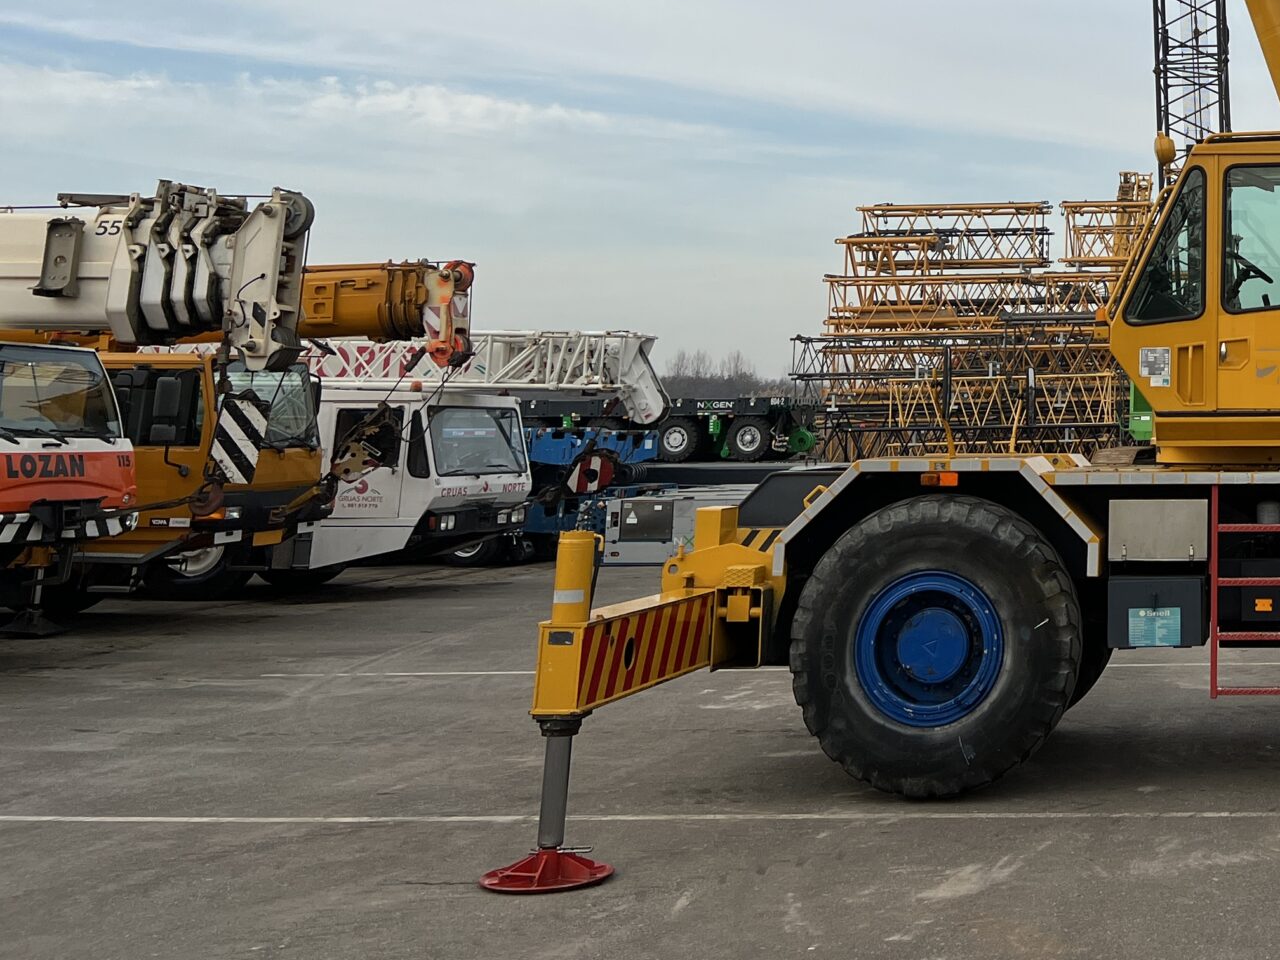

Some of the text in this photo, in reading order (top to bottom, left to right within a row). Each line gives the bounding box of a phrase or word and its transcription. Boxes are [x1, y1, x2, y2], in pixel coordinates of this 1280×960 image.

[95, 220, 122, 236] 55
[697, 401, 734, 409] NXGEN
[5, 454, 131, 478] LOZAN 115
[441, 482, 526, 497] GRUAS NORTE
[338, 495, 384, 503] GRUAS NORTE
